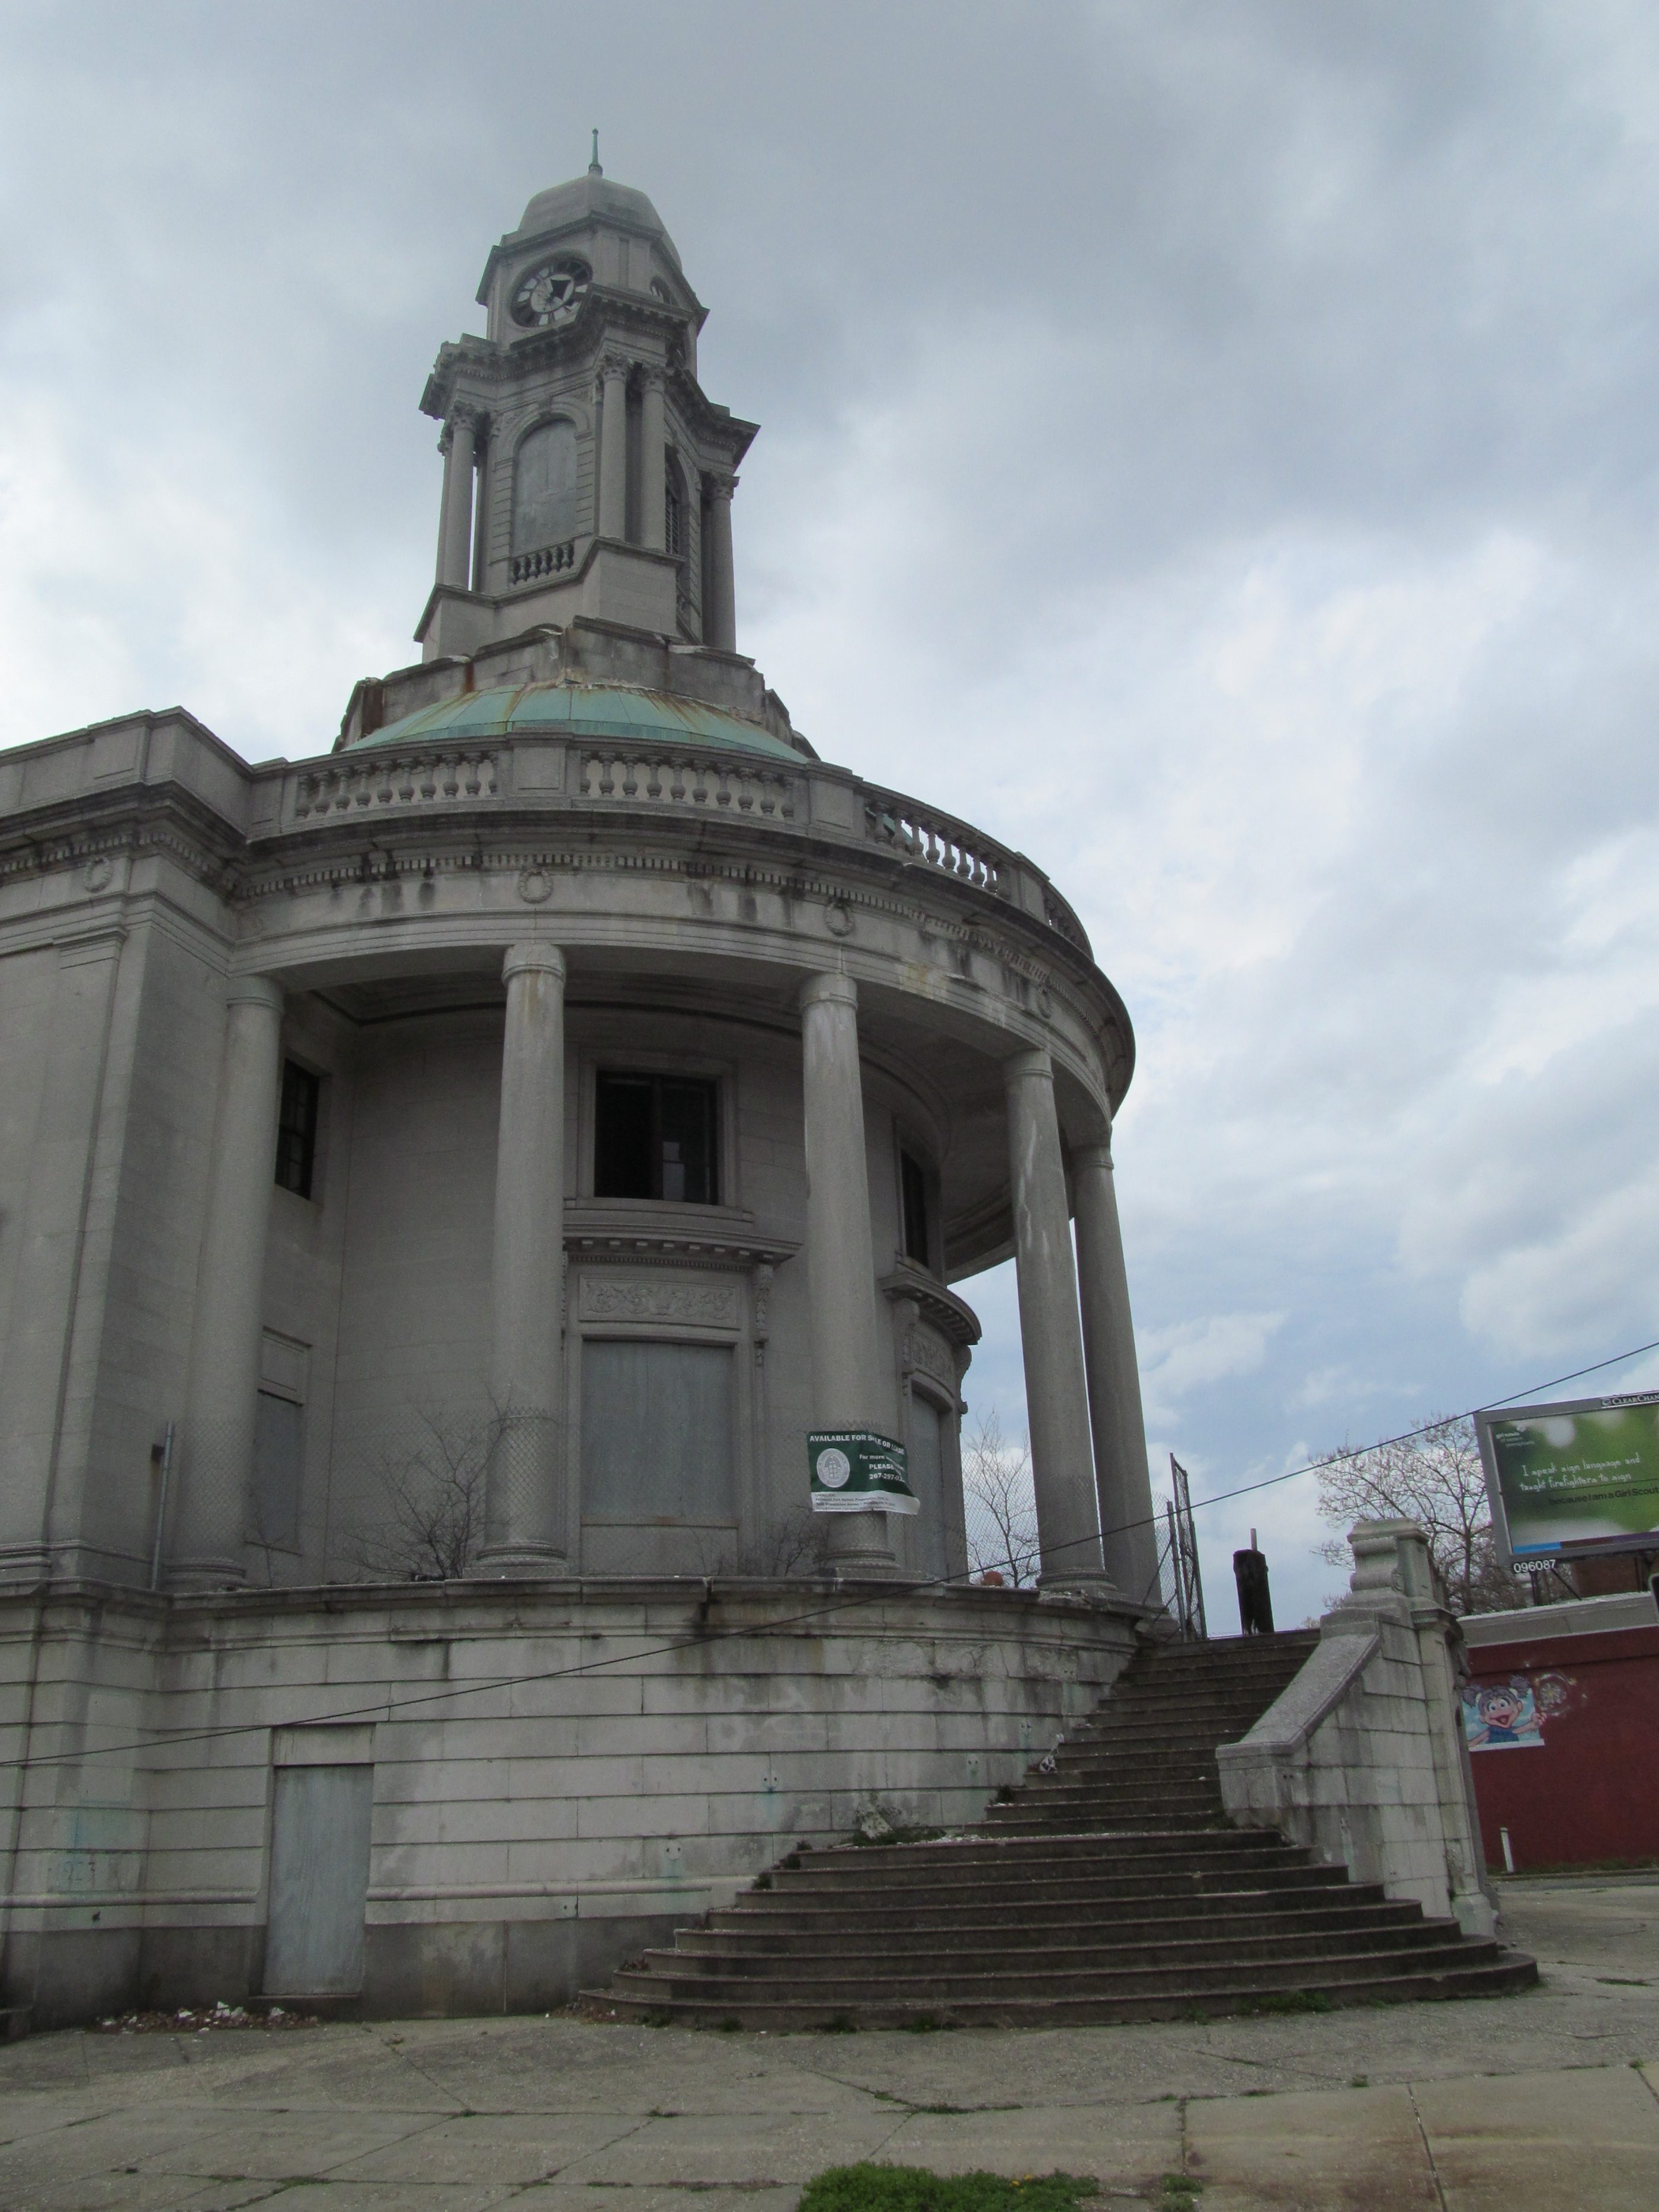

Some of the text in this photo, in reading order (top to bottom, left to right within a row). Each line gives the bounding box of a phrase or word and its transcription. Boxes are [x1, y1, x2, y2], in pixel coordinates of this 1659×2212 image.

[1532, 1462, 1556, 1477] speak
[1561, 1464, 1580, 1473] sign
[1583, 1459, 1622, 1470] language
[1625, 1452, 1640, 1464] and
[1519, 1473, 1631, 1492] taught firefighters to sign
[1549, 1495, 1587, 1505] because
[1615, 1489, 1631, 1498] Girl
[1513, 1559, 1556, 1573] 096087
